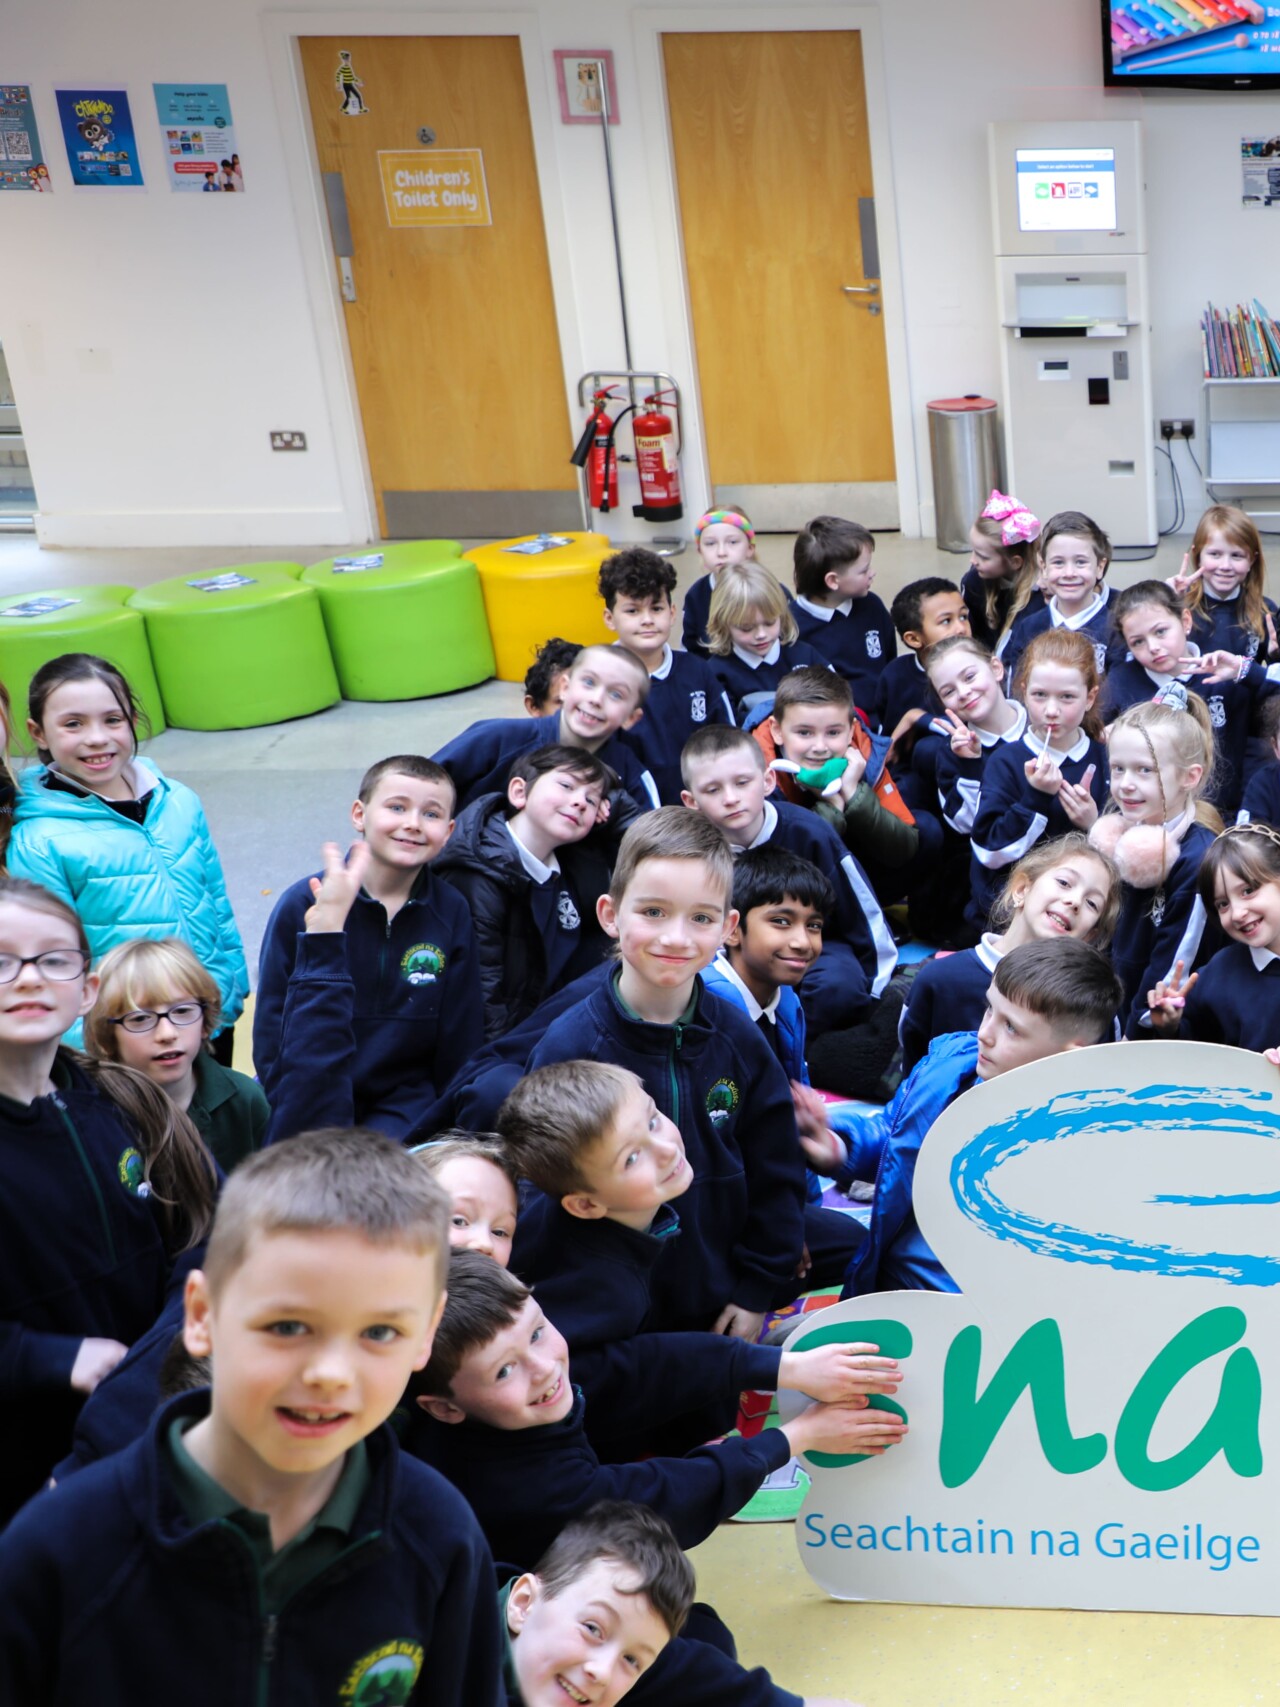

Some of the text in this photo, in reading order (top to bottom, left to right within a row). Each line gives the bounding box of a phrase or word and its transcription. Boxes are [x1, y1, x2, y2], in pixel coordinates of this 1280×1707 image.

[395, 169, 470, 188] Children's
[393, 190, 478, 212] Toilet Only
[638, 438, 660, 447] Foam
[805, 1513, 1260, 1571] Seachtain na Gaeilge
